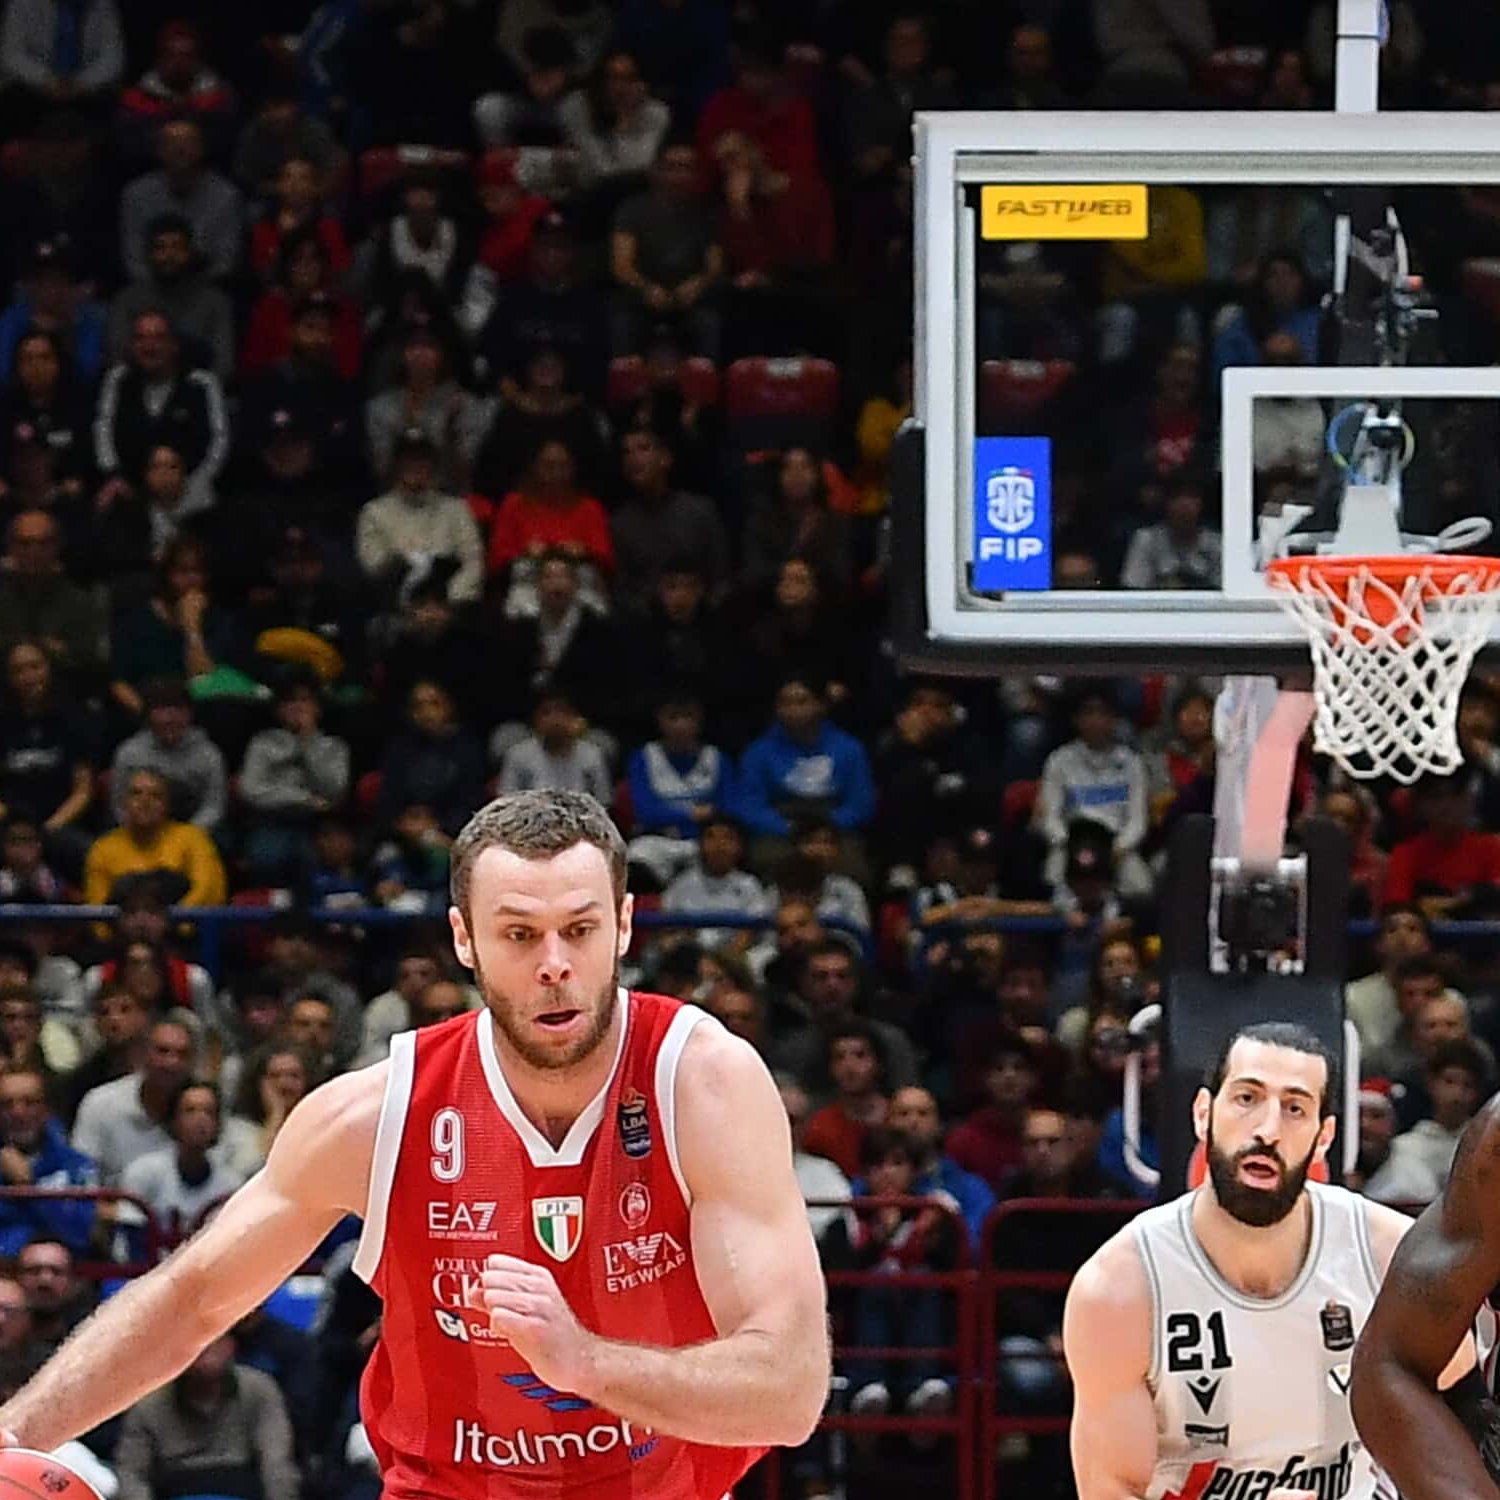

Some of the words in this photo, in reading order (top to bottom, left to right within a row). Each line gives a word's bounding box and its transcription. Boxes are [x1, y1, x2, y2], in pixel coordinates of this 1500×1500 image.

[997, 199, 1133, 222] FASTWEB
[979, 536, 1044, 562] FIP
[621, 1115, 649, 1131] LBA
[431, 1107, 465, 1183] 9
[428, 1201, 497, 1231] EA7
[607, 1255, 687, 1292] EYEWEAR
[1167, 1311, 1233, 1372] 21
[453, 1418, 651, 1467] Italmo
